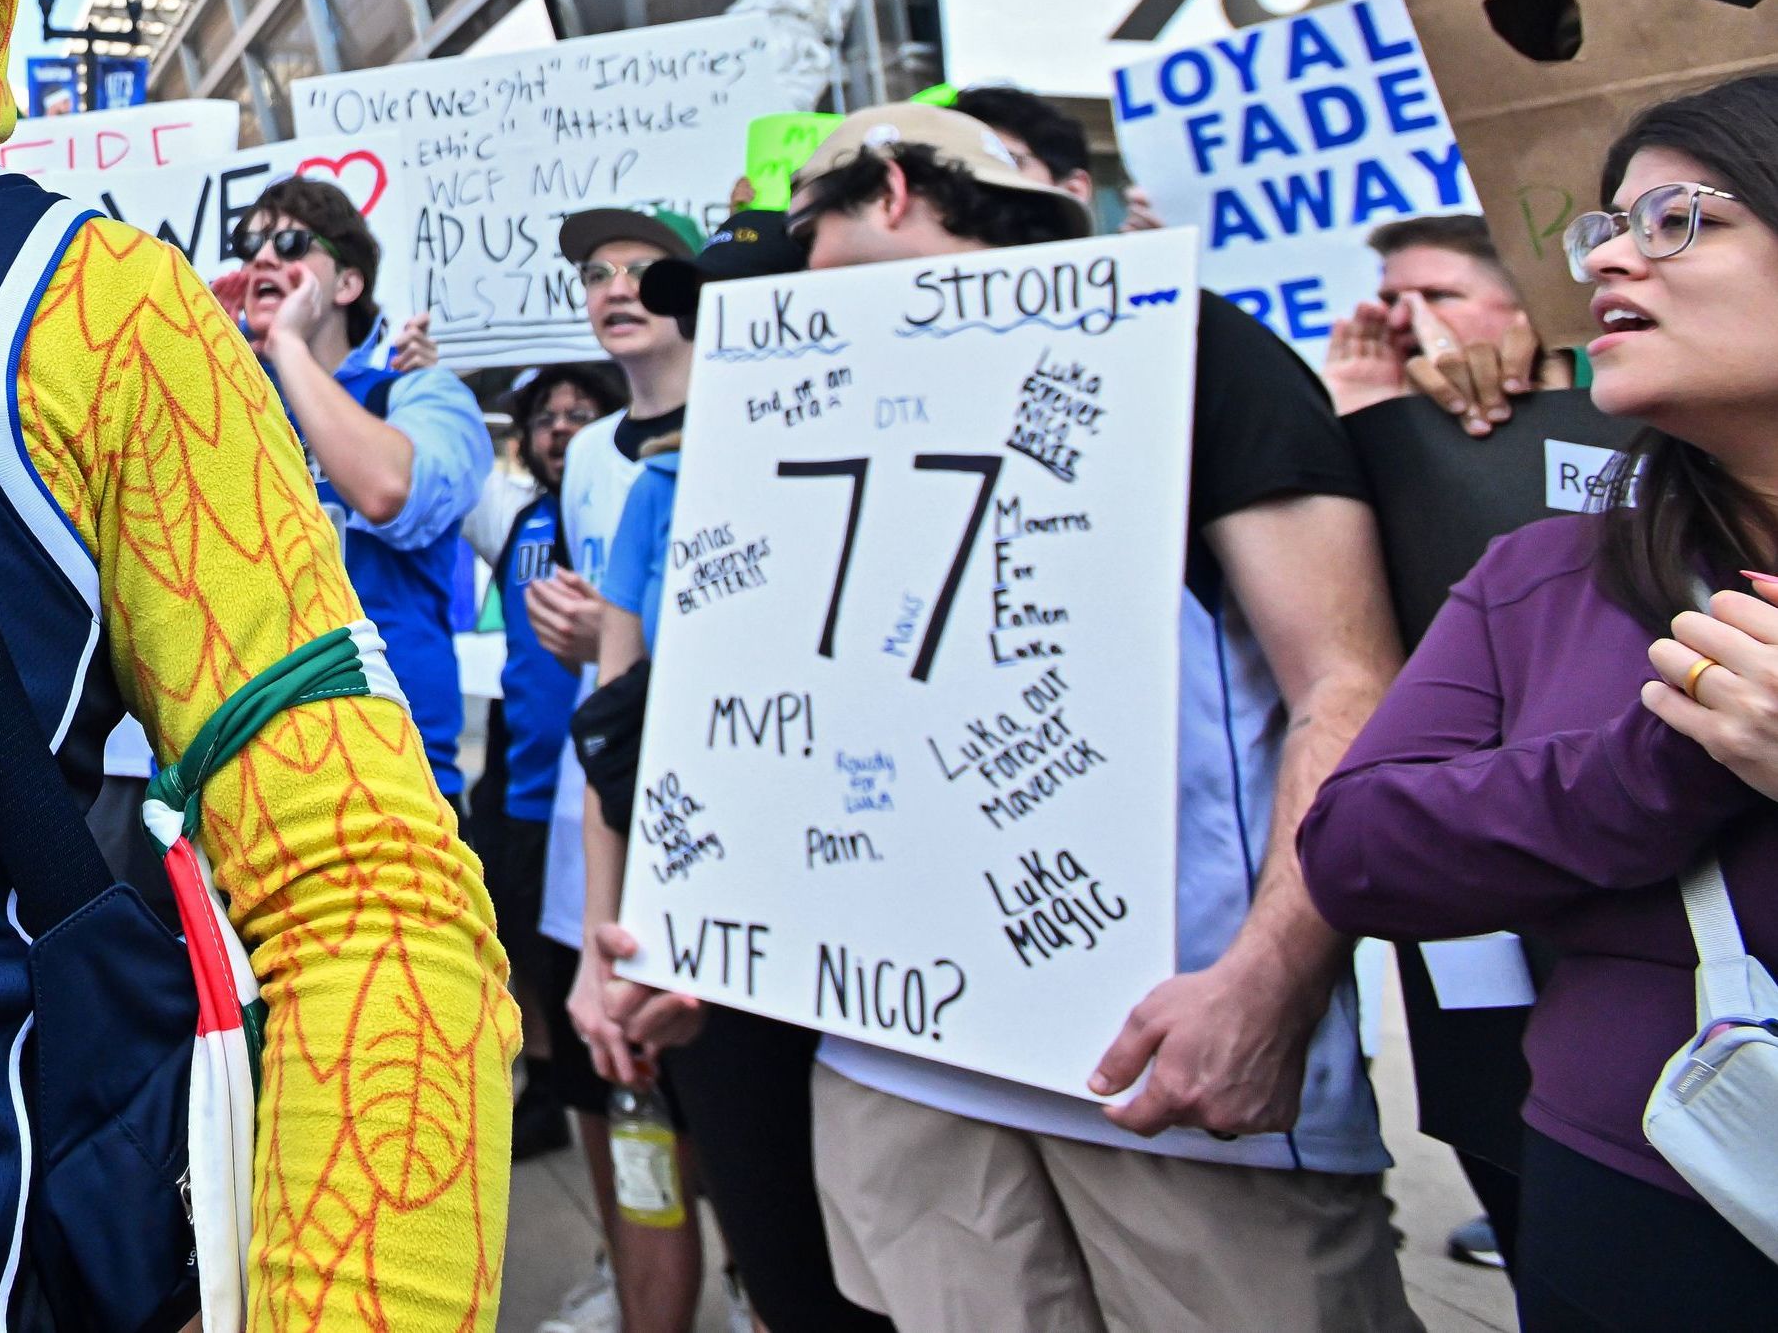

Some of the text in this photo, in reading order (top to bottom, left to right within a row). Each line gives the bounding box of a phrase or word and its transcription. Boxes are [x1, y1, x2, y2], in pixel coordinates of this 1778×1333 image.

[1113, 2, 1414, 121] LOYAL
[1184, 68, 1438, 173] FADE
[533, 149, 639, 199] MVP
[1210, 144, 1463, 248] AWAY
[715, 257, 1120, 351] Luka Strong
[672, 521, 736, 570] Dallas
[692, 536, 771, 586] deserves
[708, 692, 814, 758] MVP!
[979, 738, 1108, 830] Maverick
[664, 912, 770, 997] WTF
